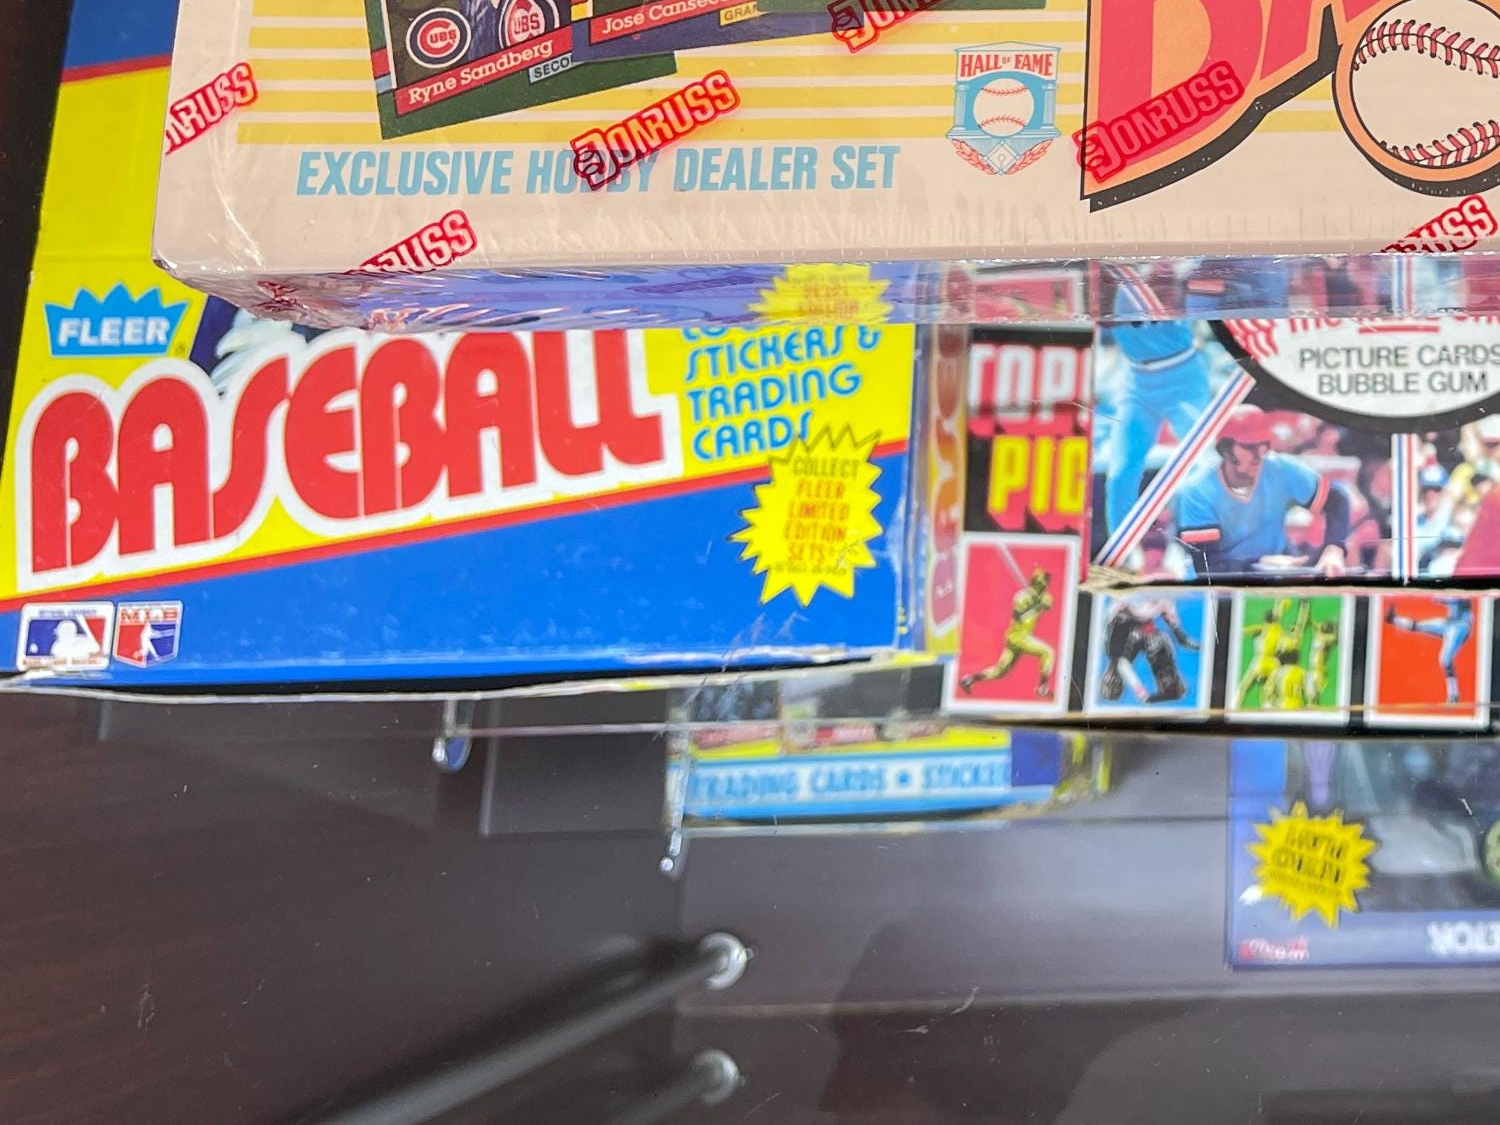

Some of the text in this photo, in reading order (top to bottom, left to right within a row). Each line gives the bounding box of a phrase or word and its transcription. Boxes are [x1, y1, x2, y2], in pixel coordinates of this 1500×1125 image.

[602, 13, 644, 34] Jose
[408, 39, 553, 105] Ryne Sandberg
[959, 54, 1002, 77] HALL
[1014, 53, 1054, 77] FAME
[570, 70, 740, 191] DONRUSS
[1075, 61, 1244, 181] DONRUSS
[296, 150, 512, 196] EXCLUSIVE
[673, 146, 818, 192] DEALER
[831, 145, 901, 190] SET
[57, 316, 171, 348] FLEER
[685, 324, 846, 383] STICKERS
[1299, 348, 1409, 370] PICTURE
[686, 362, 862, 423] TRADING
[1317, 372, 1489, 396] BUBBLE GUM
[30, 328, 665, 574] BASEBALL
[691, 410, 814, 461] CARDS
[793, 455, 860, 479] COLLECT
[795, 478, 846, 499] FLEER
[783, 520, 846, 542] EDITION
